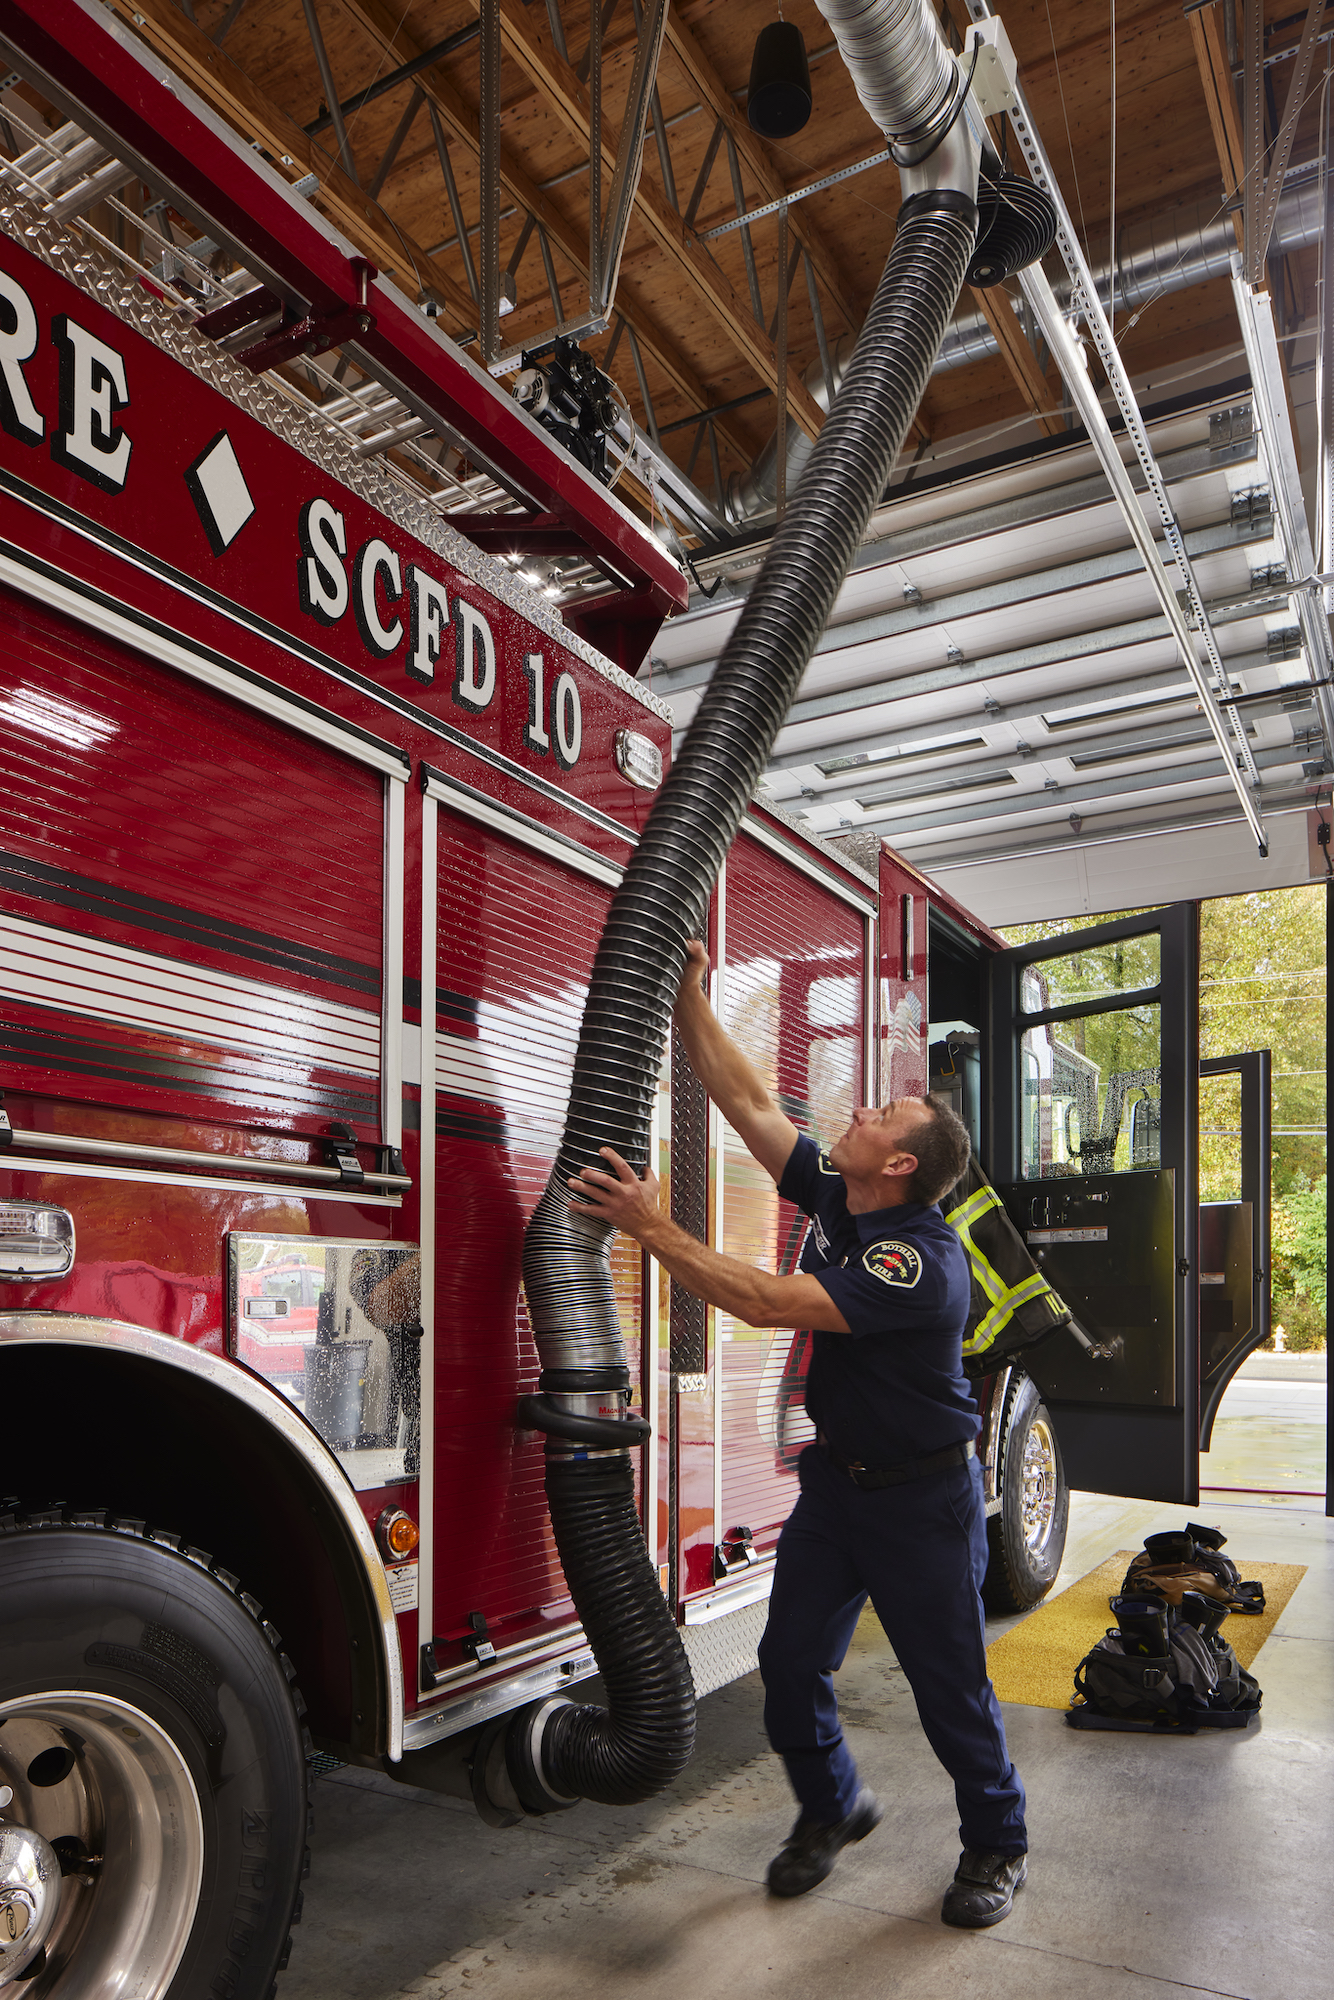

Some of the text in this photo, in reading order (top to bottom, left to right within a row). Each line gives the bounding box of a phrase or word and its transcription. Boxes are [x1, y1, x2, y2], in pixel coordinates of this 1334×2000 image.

[298, 497, 497, 712] SCFD
[523, 651, 582, 770] 10
[872, 1263, 894, 1279] FIRE
[881, 1244, 917, 1268] BOTHELL
[205, 1805, 273, 2000] BRIDG
